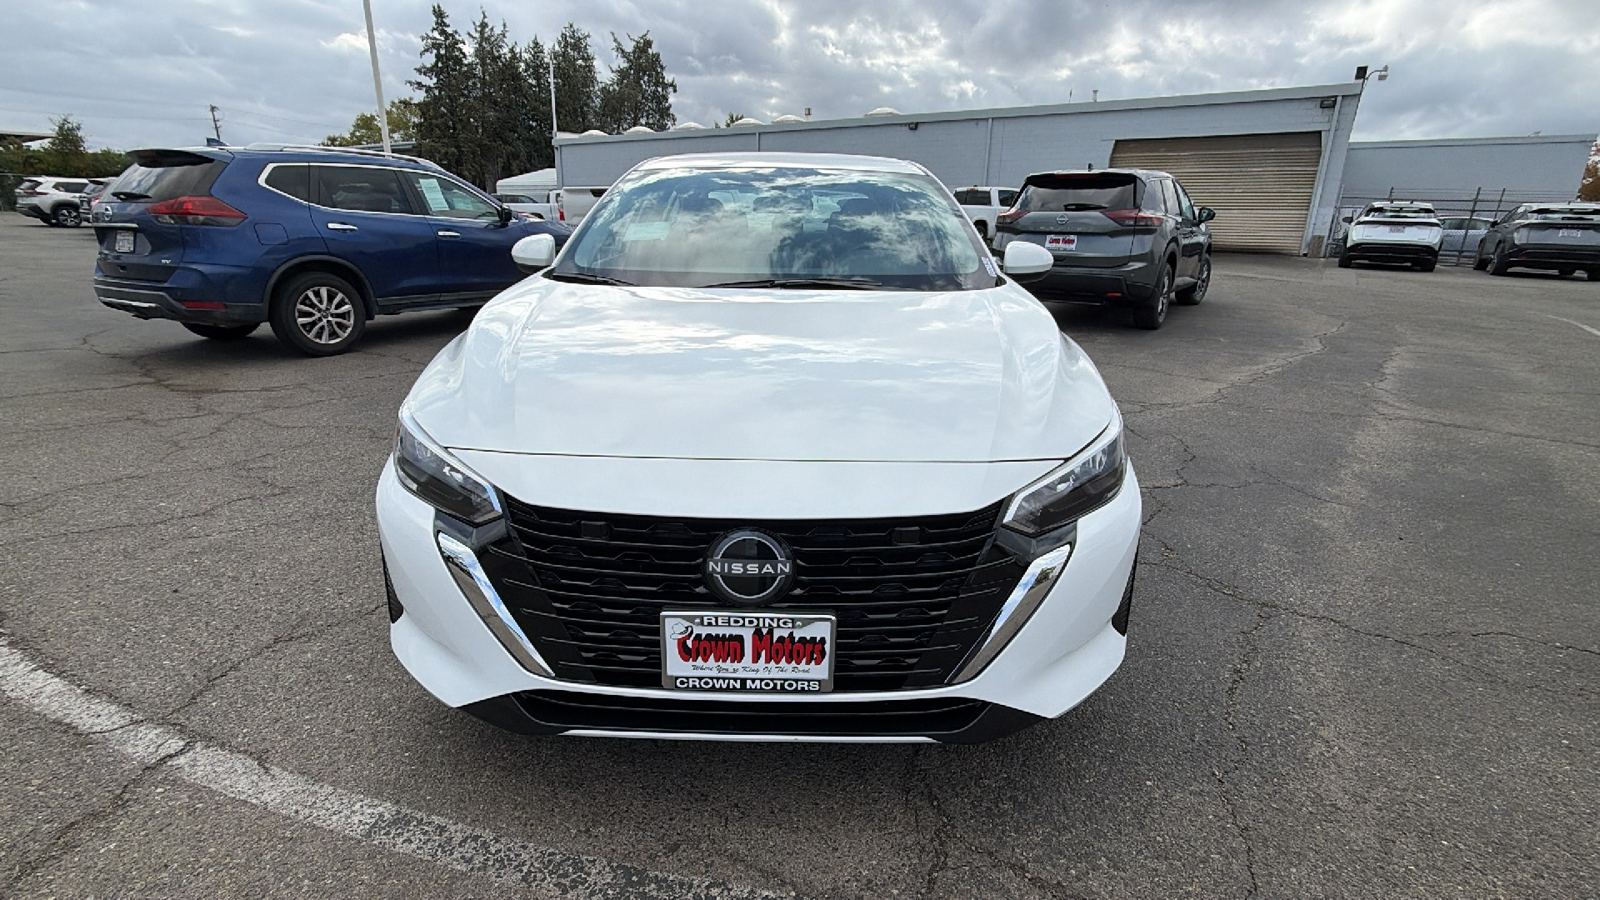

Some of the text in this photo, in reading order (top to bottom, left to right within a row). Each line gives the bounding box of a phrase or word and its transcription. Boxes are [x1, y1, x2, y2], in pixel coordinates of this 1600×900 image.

[708, 561, 790, 574] NISSAN
[703, 617, 793, 628] REDDING
[677, 628, 827, 665] Crown Motors
[692, 664, 714, 672] Where
[741, 666, 760, 674] King
[762, 666, 772, 675] Of
[676, 678, 820, 691] CROWN MOTORS
